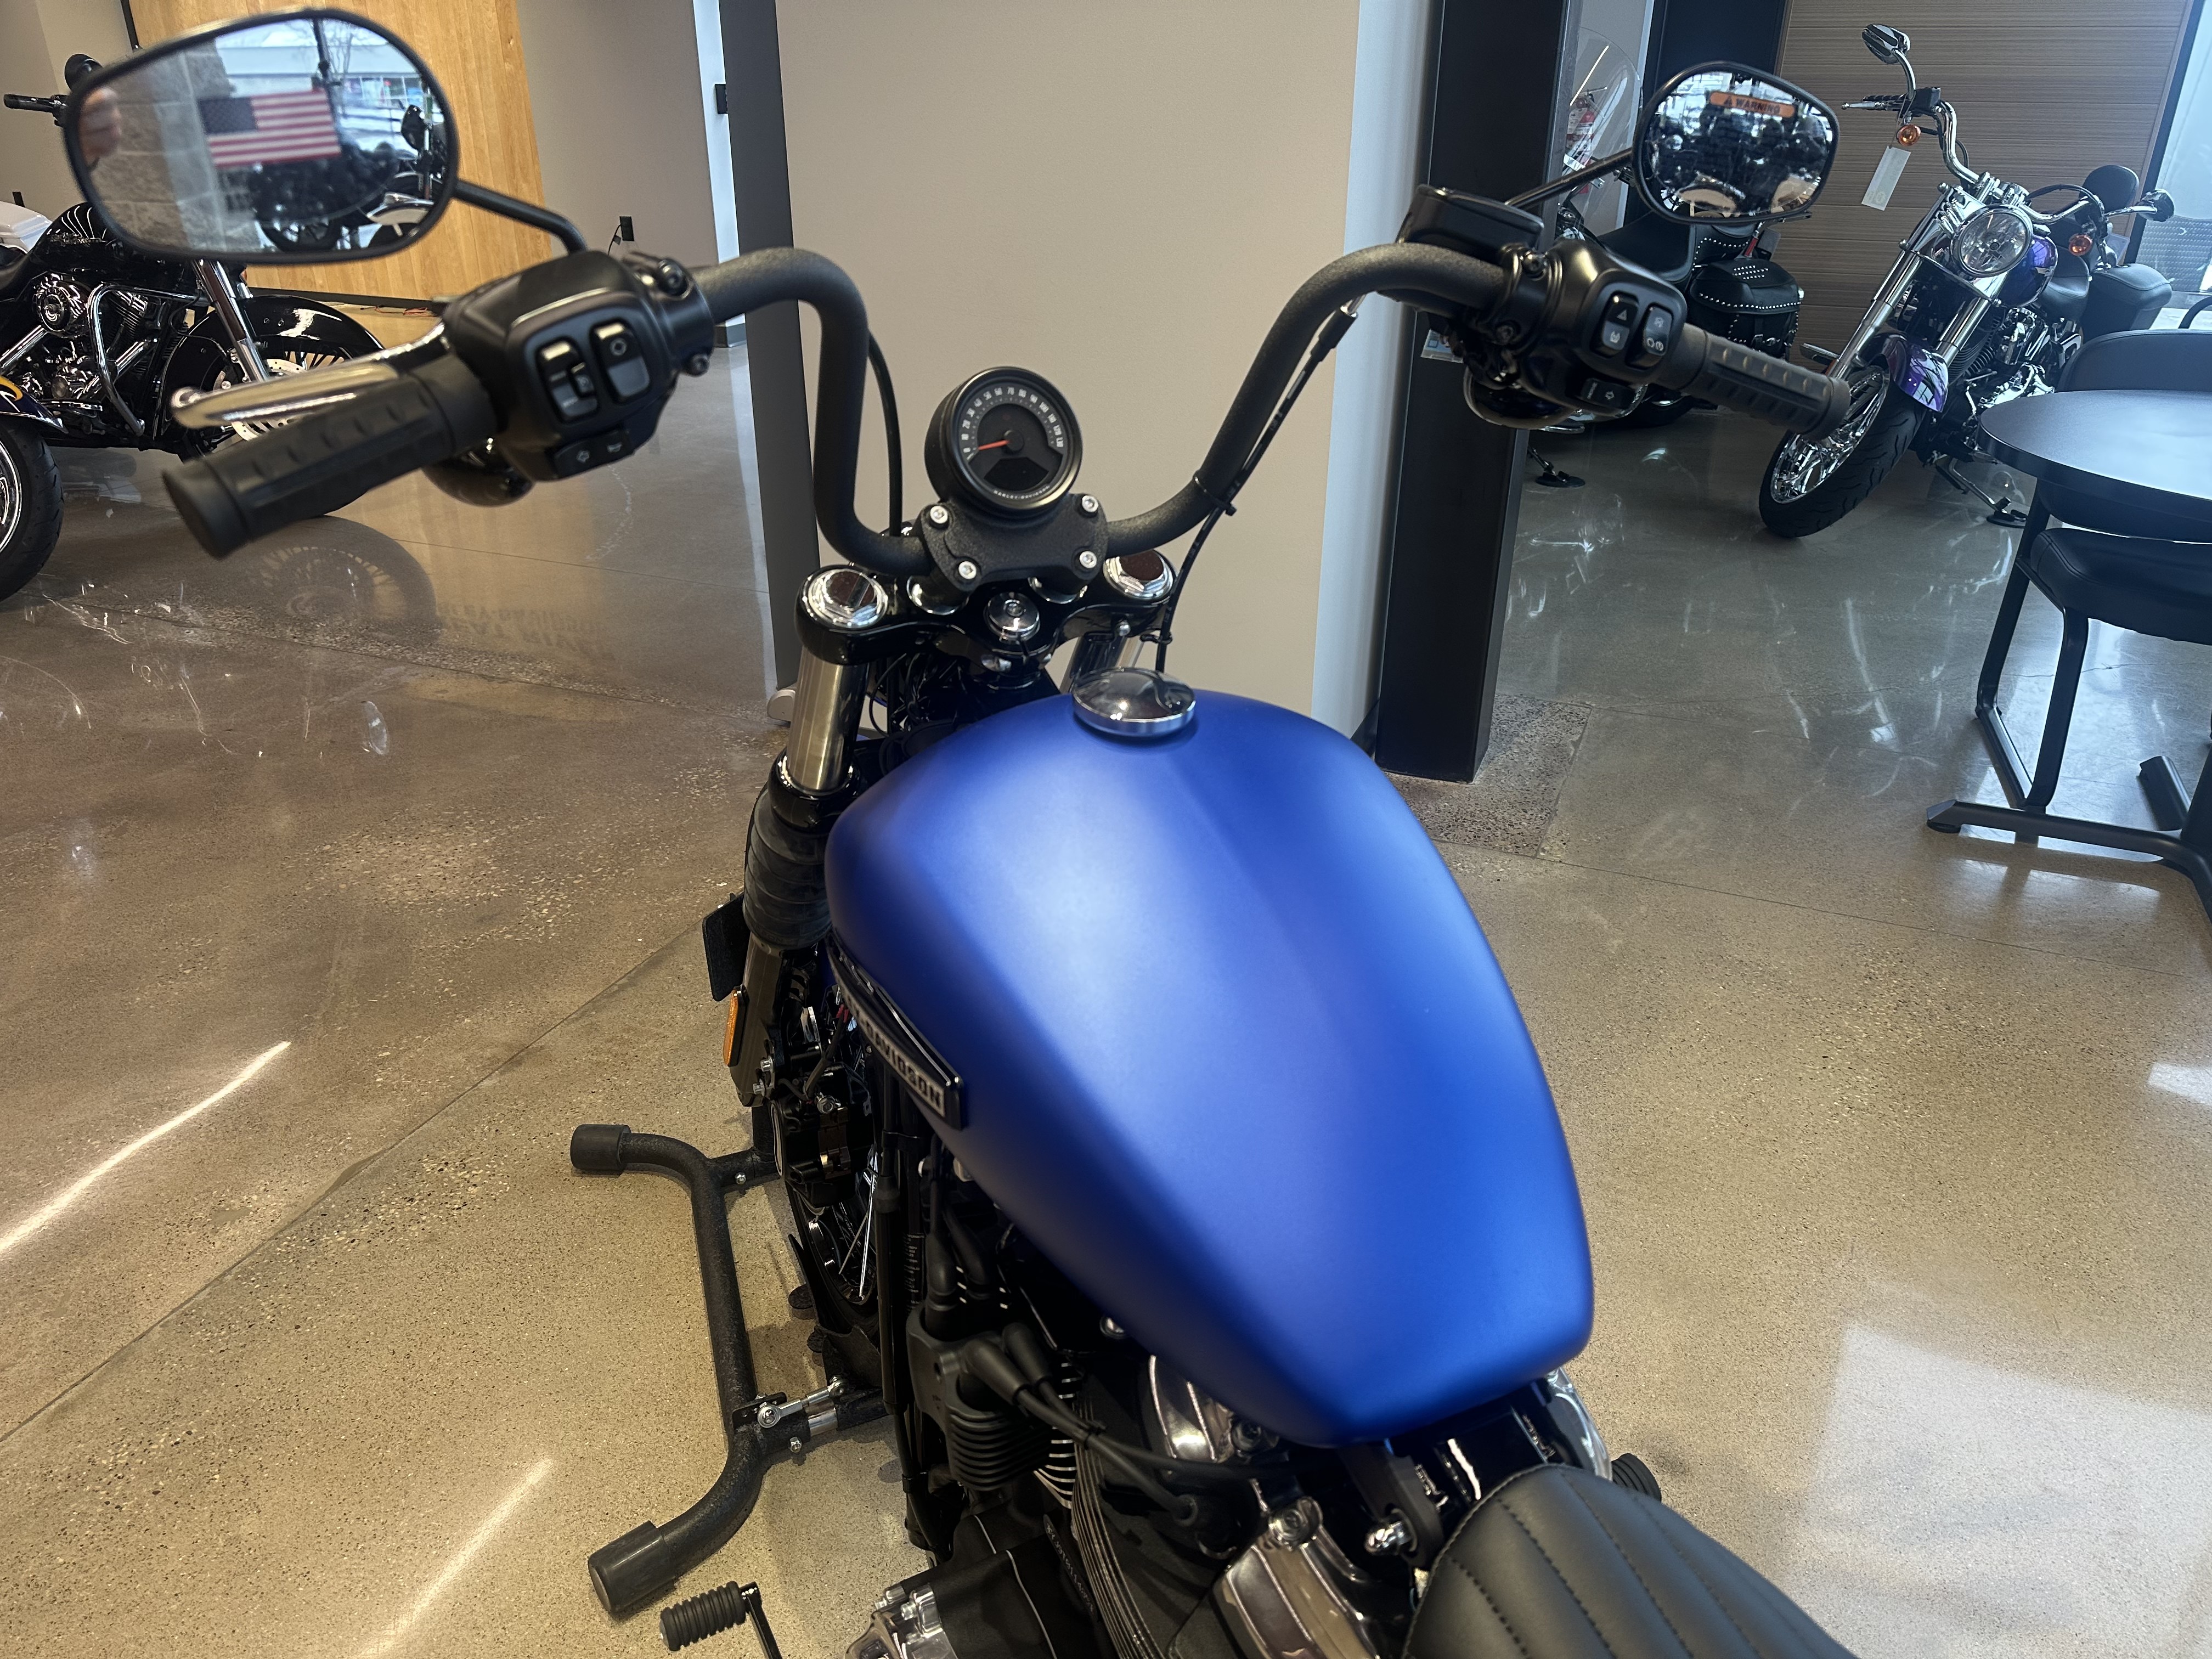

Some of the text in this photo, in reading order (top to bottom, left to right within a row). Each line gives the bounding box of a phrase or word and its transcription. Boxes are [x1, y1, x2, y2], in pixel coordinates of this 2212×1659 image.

[1735, 97, 1781, 115] WARNING
[983, 391, 992, 399] 50
[994, 387, 1002, 396] 60
[1007, 387, 1014, 395] 70
[1018, 388, 1026, 398] 80
[974, 398, 982, 406] 40
[1030, 394, 1038, 403] 90
[967, 408, 975, 417] 30
[1039, 402, 1049, 413] 100
[1047, 413, 1057, 423] 110
[962, 419, 970, 429] 20
[1053, 425, 1062, 435] 120
[994, 486, 1050, 499] HARLEY-DAVIDSON
